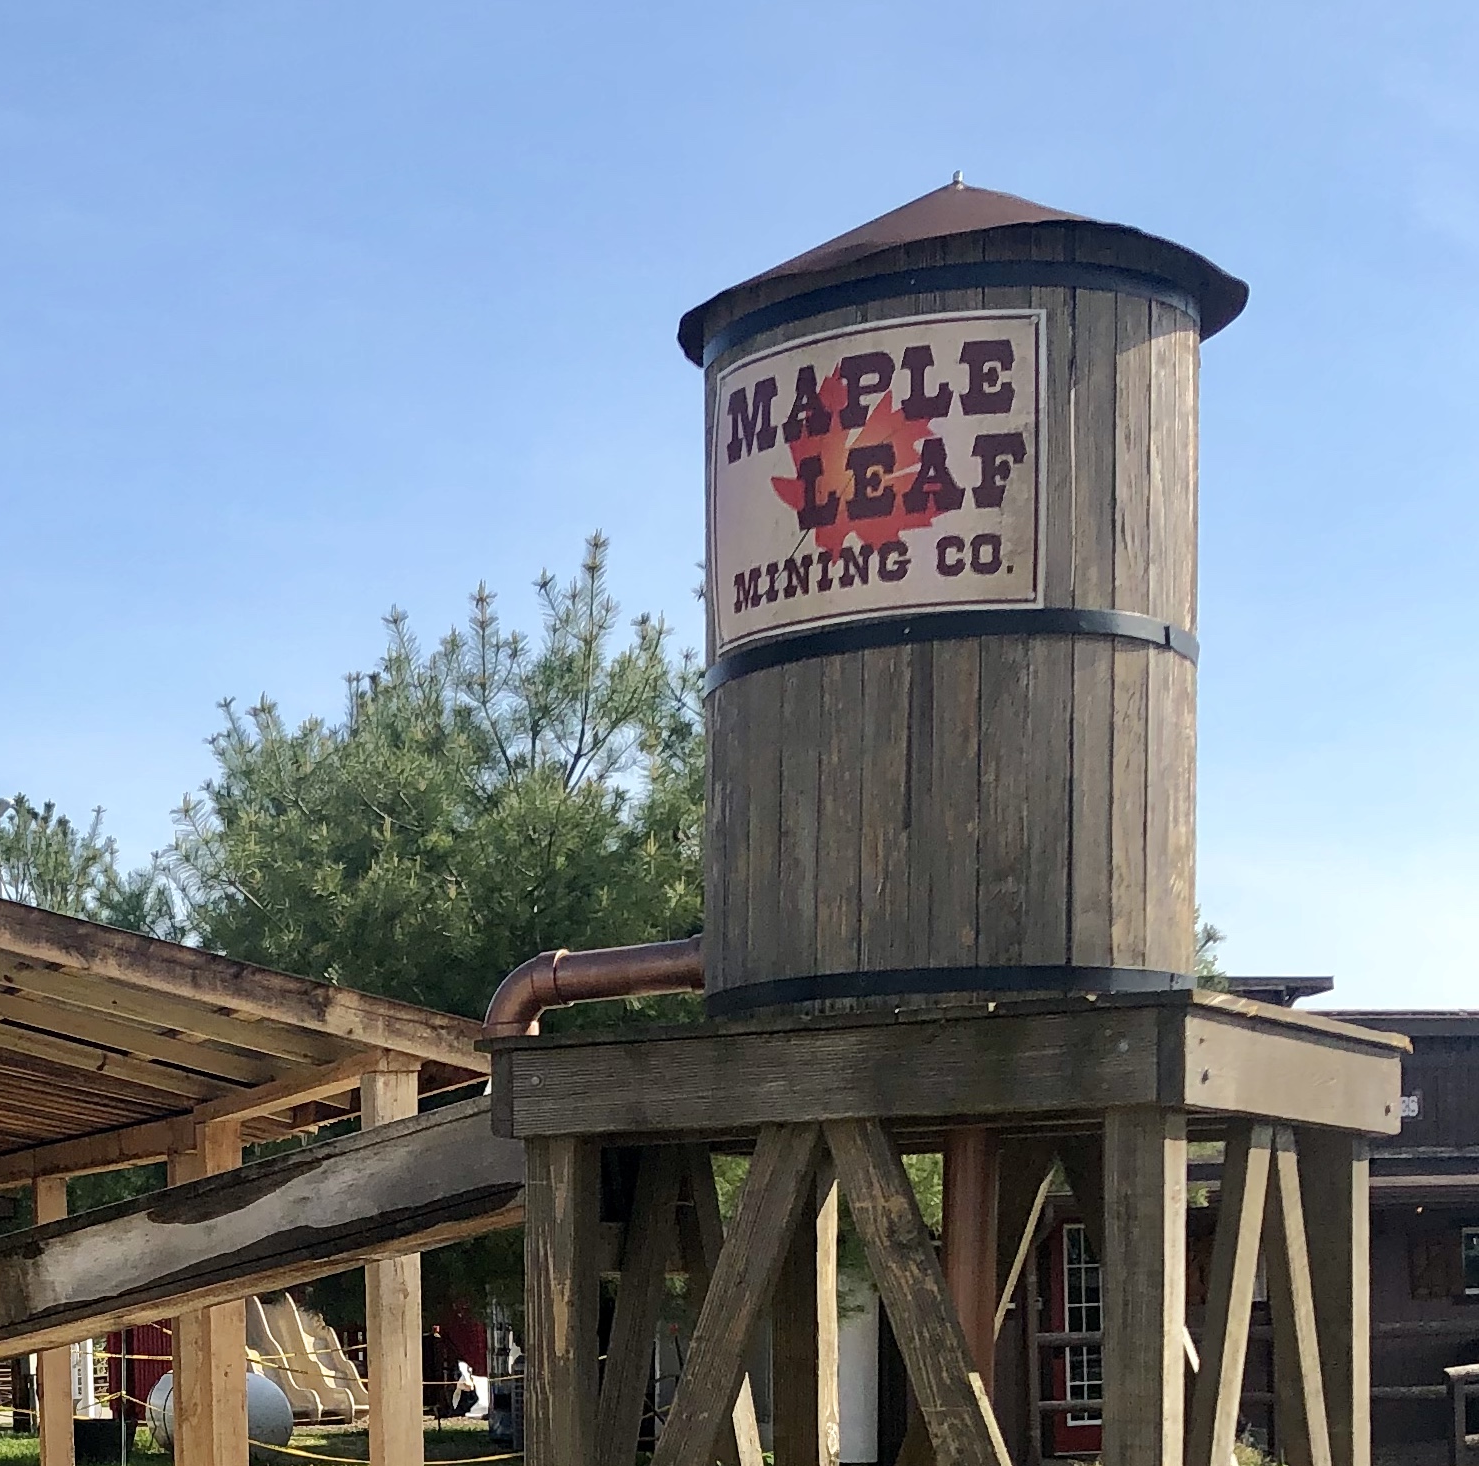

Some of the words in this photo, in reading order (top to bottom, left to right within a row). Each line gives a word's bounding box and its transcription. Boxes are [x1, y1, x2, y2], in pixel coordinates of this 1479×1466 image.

[726, 338, 1017, 464] MAPLE
[796, 432, 1028, 531] LEAF
[733, 541, 911, 613] MINING
[935, 533, 1015, 577] CO.
